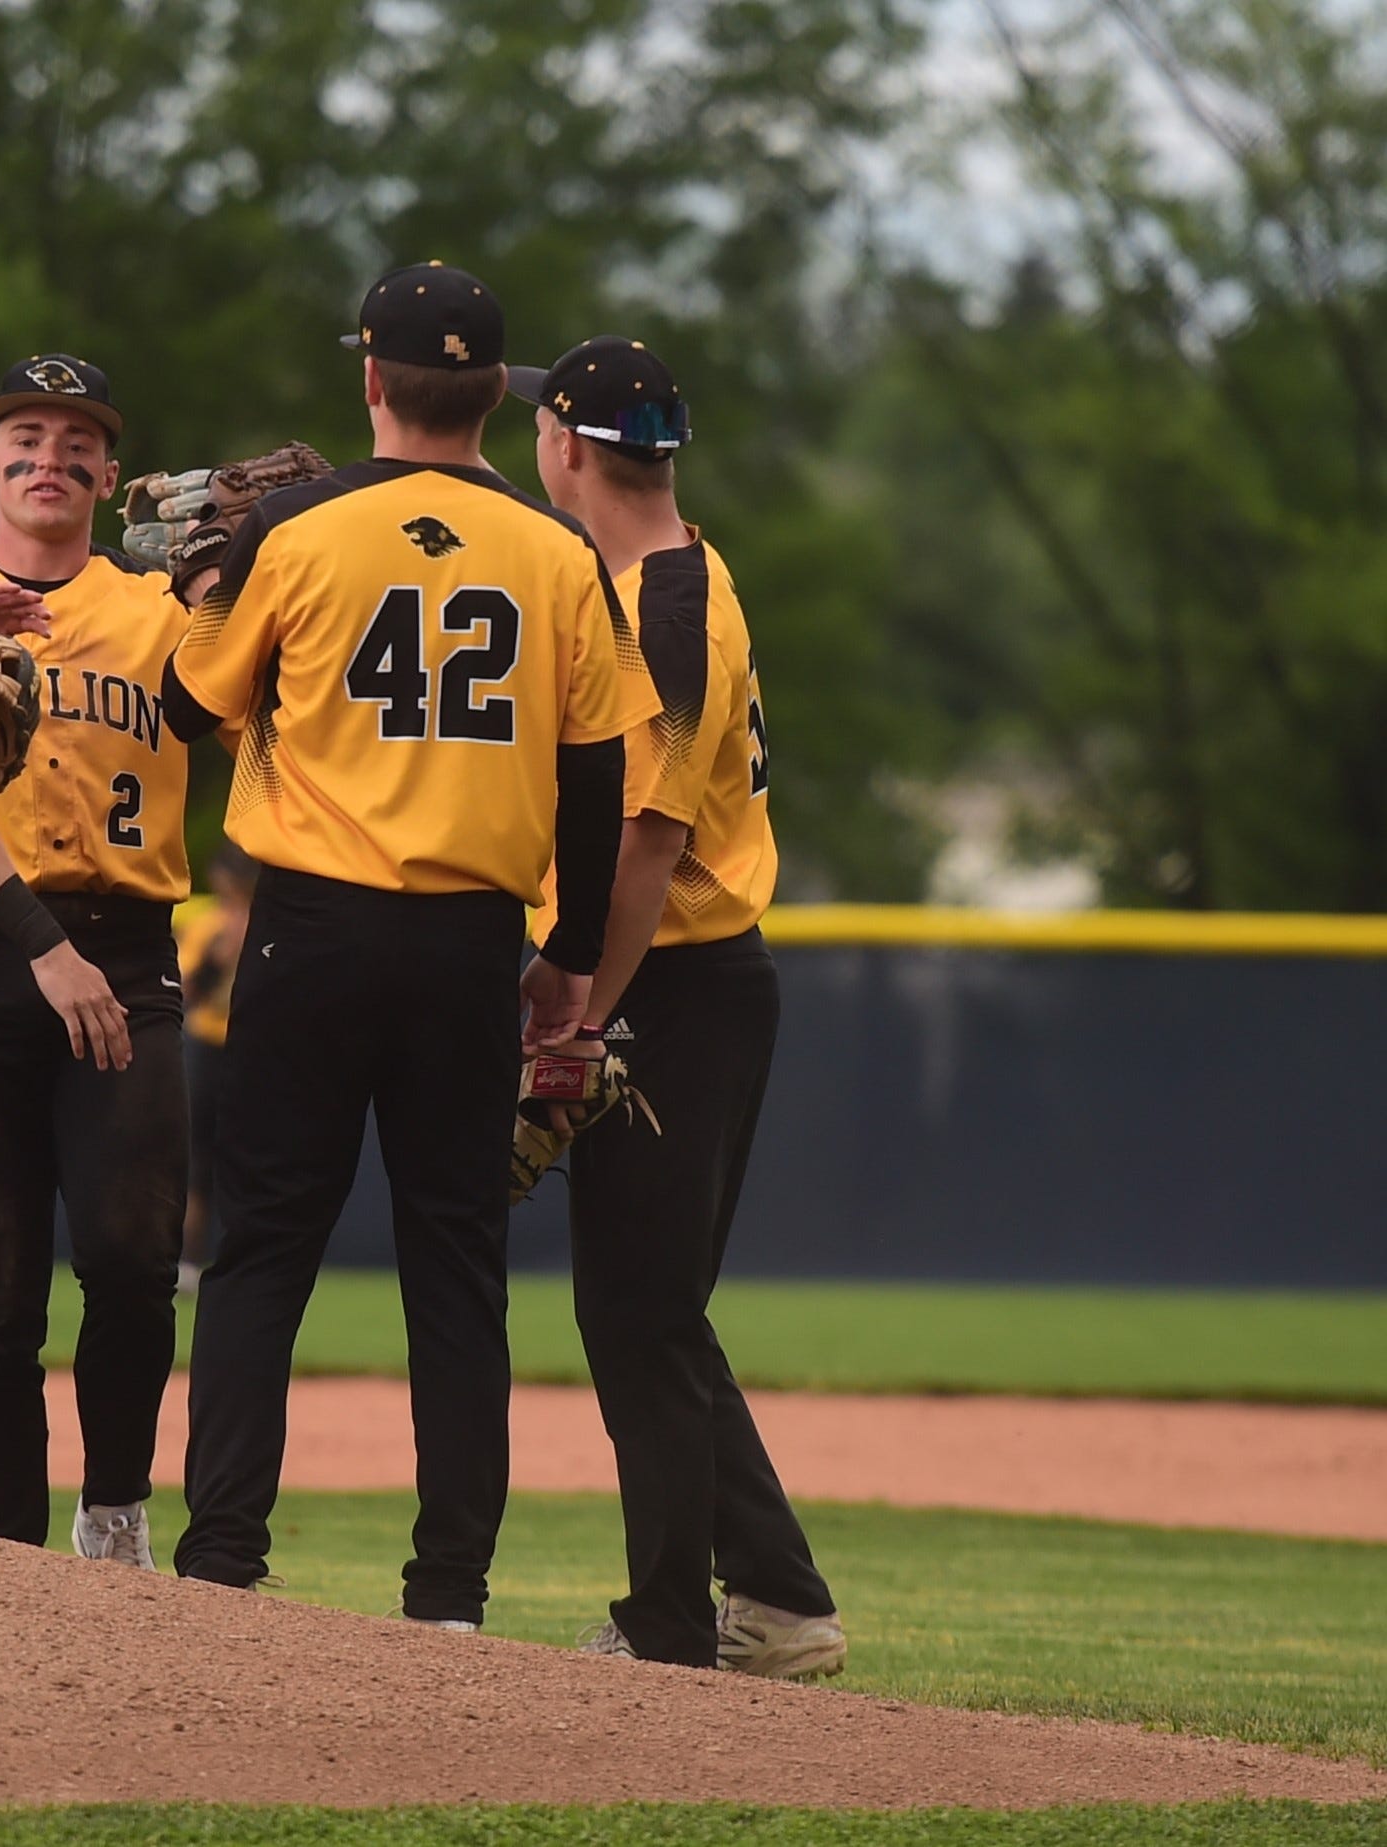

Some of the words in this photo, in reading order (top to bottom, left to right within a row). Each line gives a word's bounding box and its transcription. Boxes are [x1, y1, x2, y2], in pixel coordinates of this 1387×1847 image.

[181, 533, 229, 559] Wilson
[344, 585, 522, 745] 42
[45, 667, 162, 754] LION
[106, 771, 144, 849] 2
